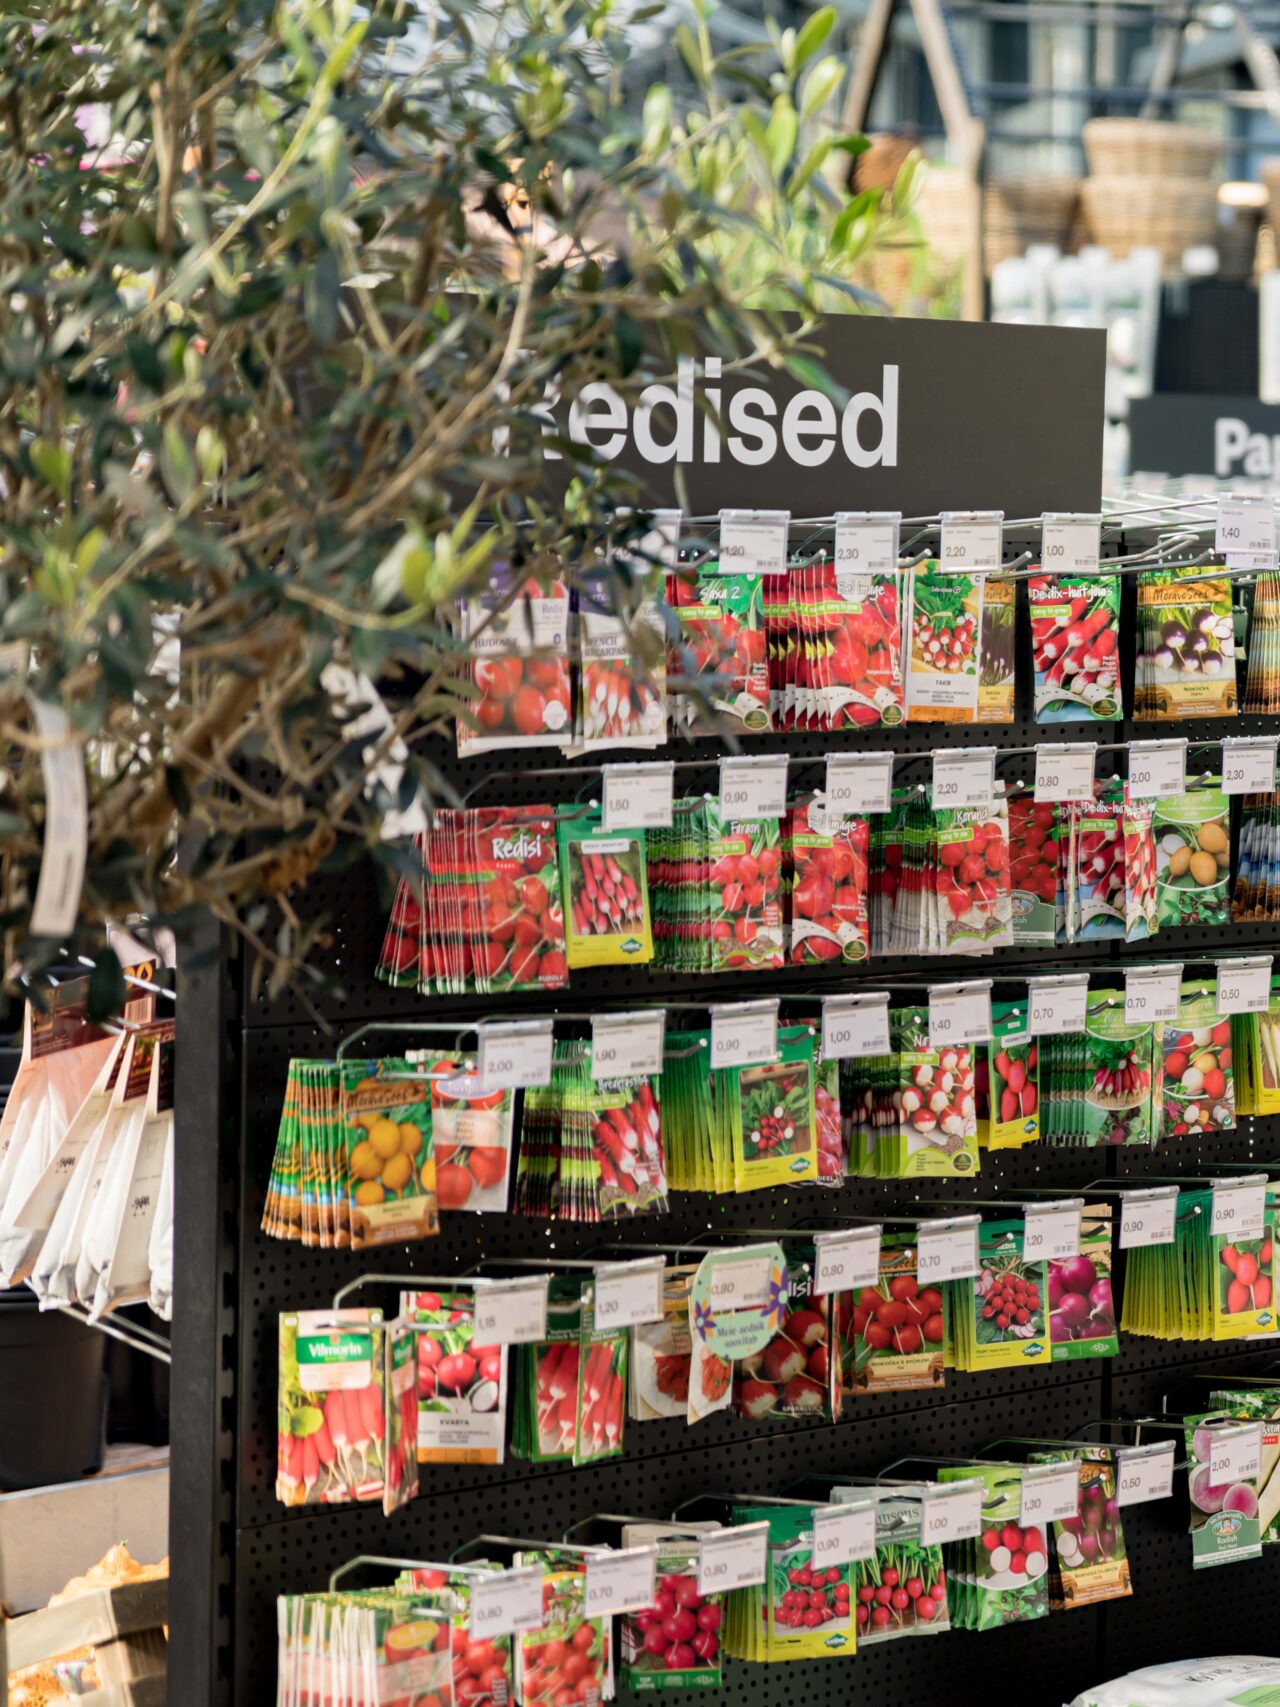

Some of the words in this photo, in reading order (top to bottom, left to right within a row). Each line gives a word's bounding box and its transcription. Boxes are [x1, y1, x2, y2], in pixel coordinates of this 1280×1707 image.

[1222, 528, 1240, 538] 1,40
[835, 548, 859, 560] 2,30
[946, 546, 966, 557] 2,20
[1045, 545, 1064, 557] 1,00
[731, 586, 741, 600] 2
[1129, 772, 1150, 784] 2,00
[1227, 770, 1244, 780] 2,30
[1038, 776, 1059, 787] 0,80
[938, 783, 957, 794] 2,20
[828, 819, 857, 836] image
[1220, 989, 1239, 1000] 0,50
[1126, 997, 1146, 1009] 0,70
[1032, 1008, 1053, 1019] 0,70
[932, 1019, 951, 1031] 1,40
[830, 1030, 850, 1043] 1,00
[716, 1039, 739, 1052] 0,90
[488, 1060, 513, 1073] 2,00
[1216, 1209, 1234, 1220] 0,90
[1122, 1219, 1143, 1232] 0,90
[1024, 1233, 1043, 1246] 1,20
[918, 1254, 940, 1268] 0,70
[820, 1264, 844, 1277] 0,80
[596, 1300, 618, 1315] 1,20
[308, 1341, 362, 1359] Vilmorin
[1210, 1458, 1230, 1472] 2,00
[1120, 1475, 1140, 1489] 0,50
[1024, 1499, 1041, 1511] 1,30
[929, 1517, 948, 1530] 1,00
[1217, 1535, 1238, 1544] Radish
[589, 1586, 613, 1600] 0,70
